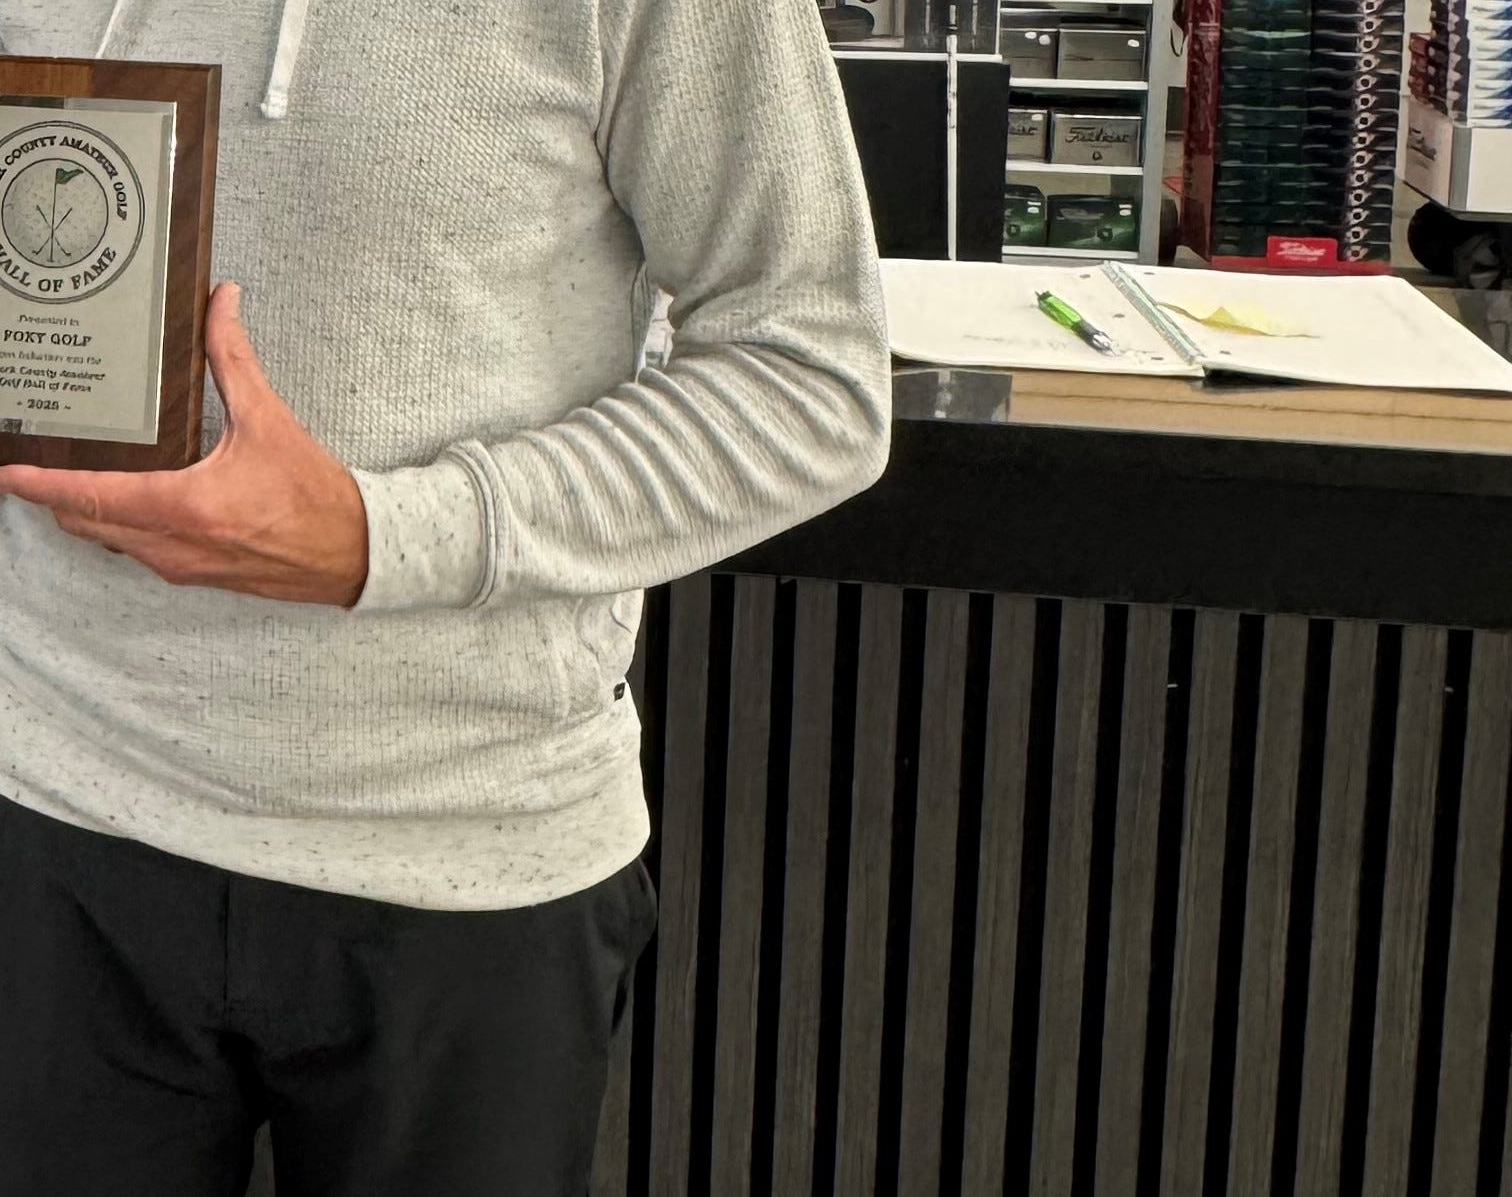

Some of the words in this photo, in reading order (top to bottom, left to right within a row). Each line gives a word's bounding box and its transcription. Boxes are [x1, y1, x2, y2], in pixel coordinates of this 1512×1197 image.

[4, 136, 57, 166] COUNTY
[59, 136, 118, 181] AMATEUR
[113, 182, 128, 221] GOLF
[38, 279, 64, 292] OF
[71, 247, 116, 289] FAME
[51, 333, 92, 348] GOLF
[20, 365, 57, 379] County
[23, 378, 46, 390] Hall
[49, 381, 59, 391] of
[62, 382, 92, 393] Fame
